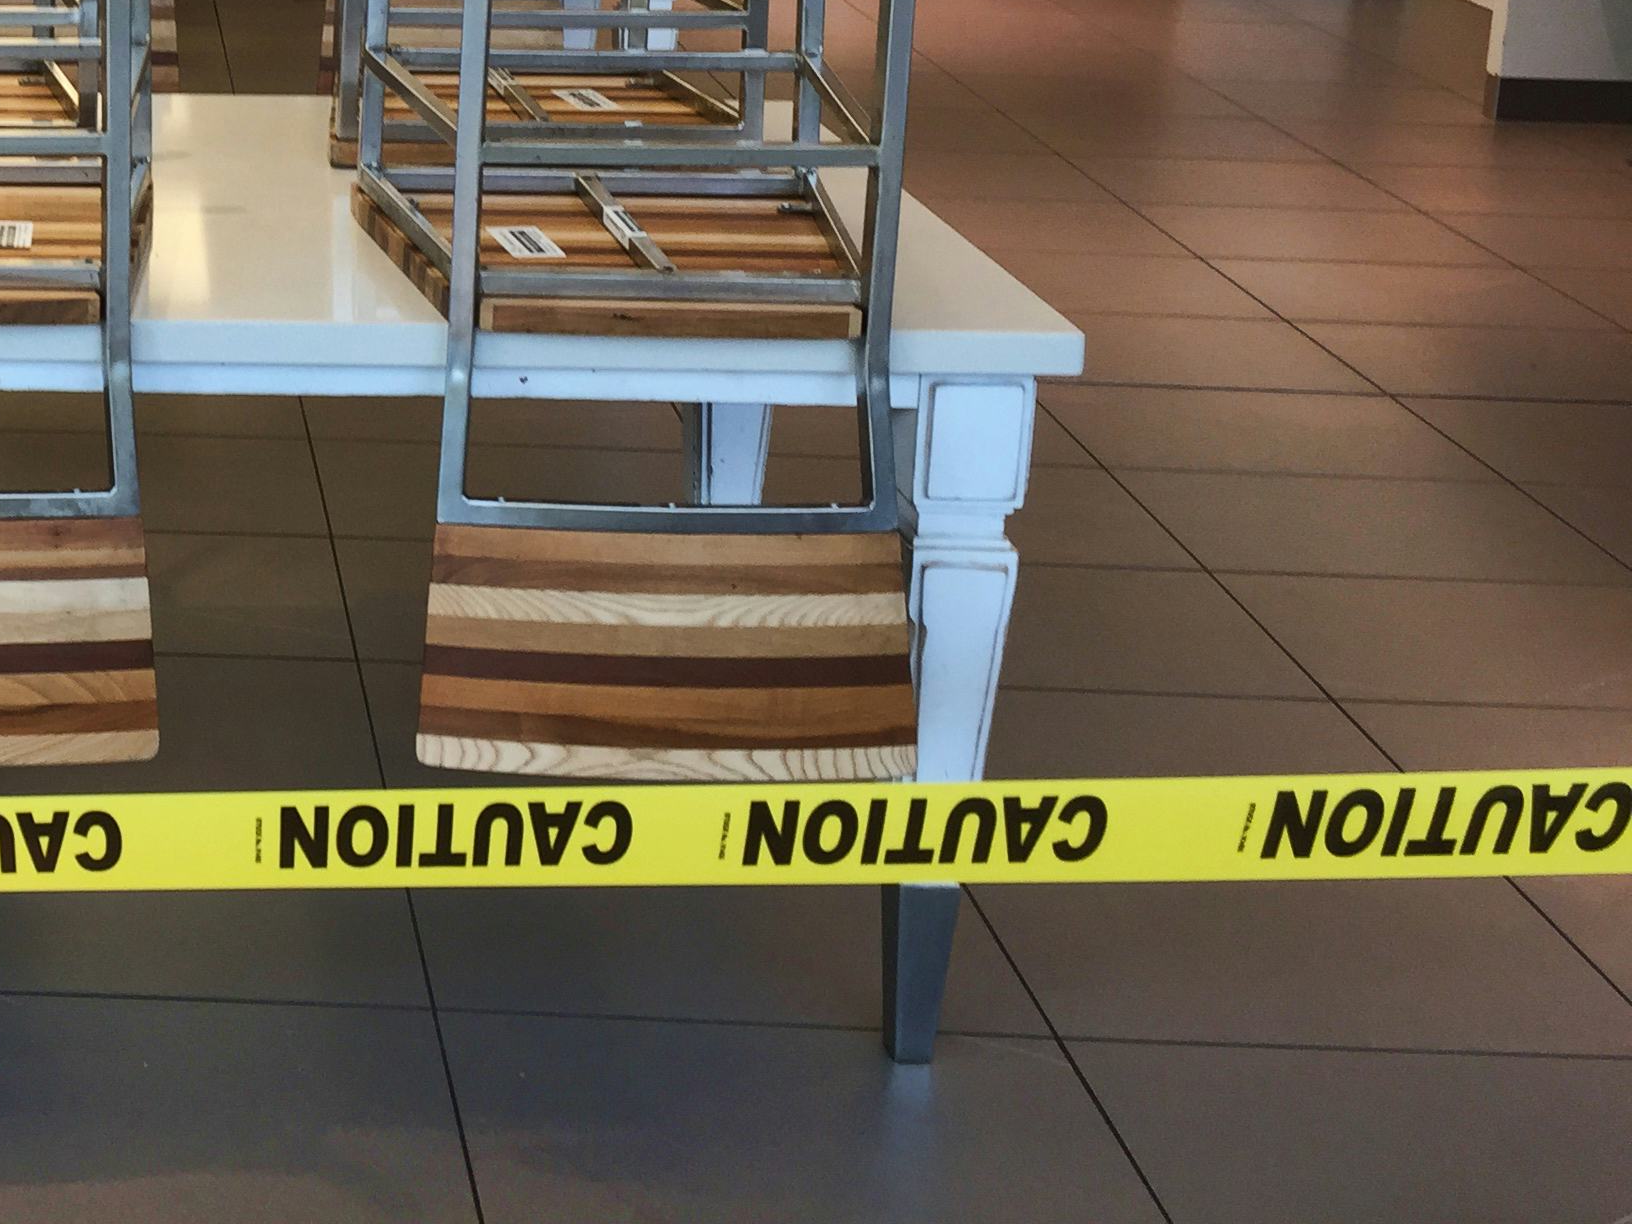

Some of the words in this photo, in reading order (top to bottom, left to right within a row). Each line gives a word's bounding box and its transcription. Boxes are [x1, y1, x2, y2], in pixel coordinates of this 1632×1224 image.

[279, 800, 634, 869] CAUTION
[740, 794, 1109, 866] CAUTION
[1259, 781, 1632, 860] CAUTION
